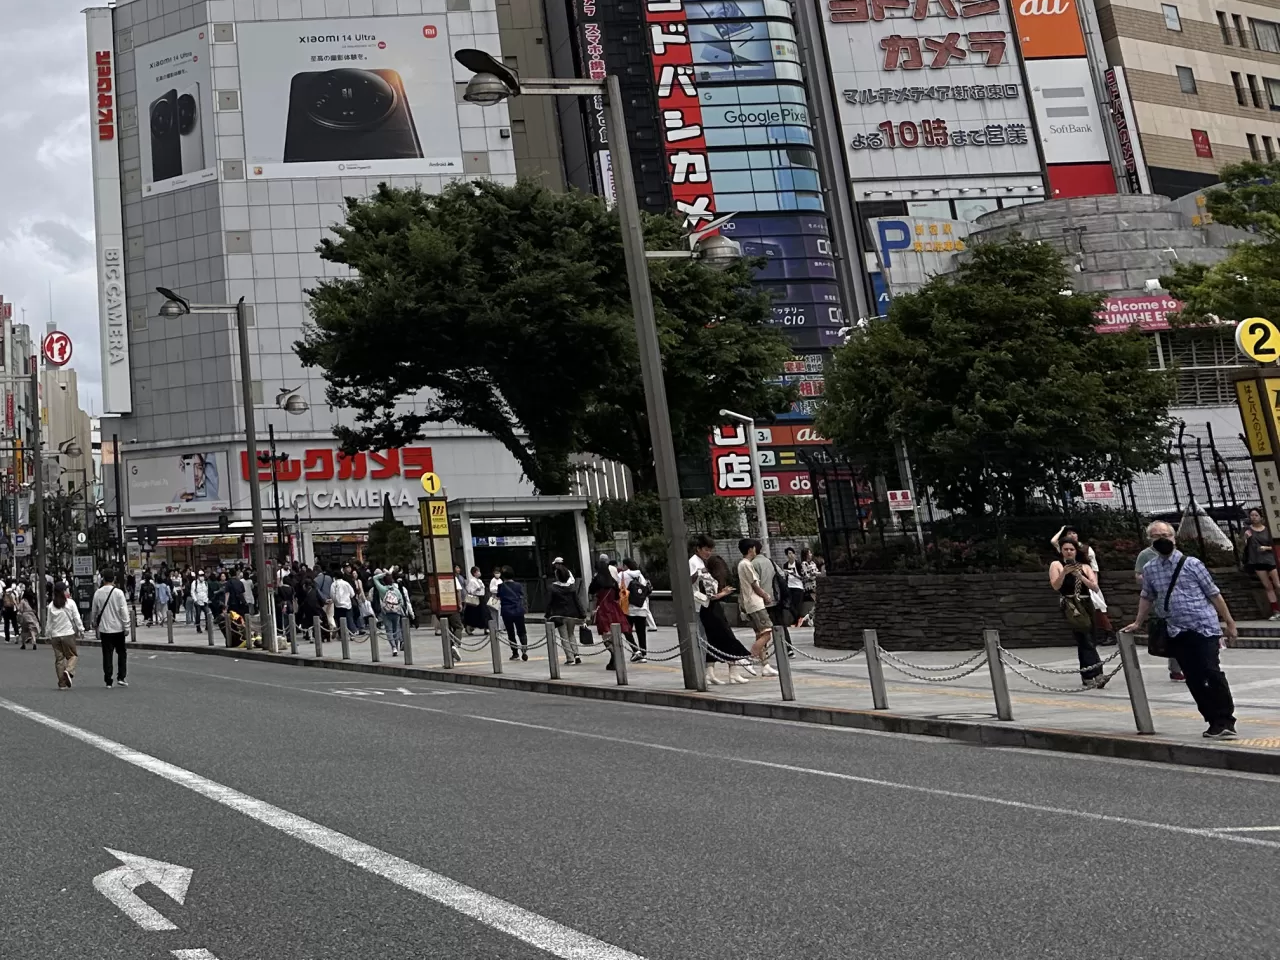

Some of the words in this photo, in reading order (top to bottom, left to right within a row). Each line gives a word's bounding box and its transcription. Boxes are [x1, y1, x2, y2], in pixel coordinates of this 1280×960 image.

[342, 34, 352, 42] 14
[355, 33, 376, 41] Ultra
[880, 30, 1007, 71] カメラ
[724, 110, 780, 126] Google
[1049, 123, 1093, 134] SoftBank
[1106, 70, 1135, 172] ヨドバシカメラ
[851, 118, 1028, 149] よる10時まで営業
[877, 221, 911, 268] P
[105, 249, 120, 281] BIC
[1162, 299, 1177, 309] to
[106, 283, 125, 366] CAMERA
[1099, 311, 1153, 326] UMINE
[1248, 322, 1276, 356] 2
[426, 475, 435, 491] 1
[269, 490, 308, 509] BIC
[312, 488, 414, 509] CAMERA
[16, 535, 25, 546] P
